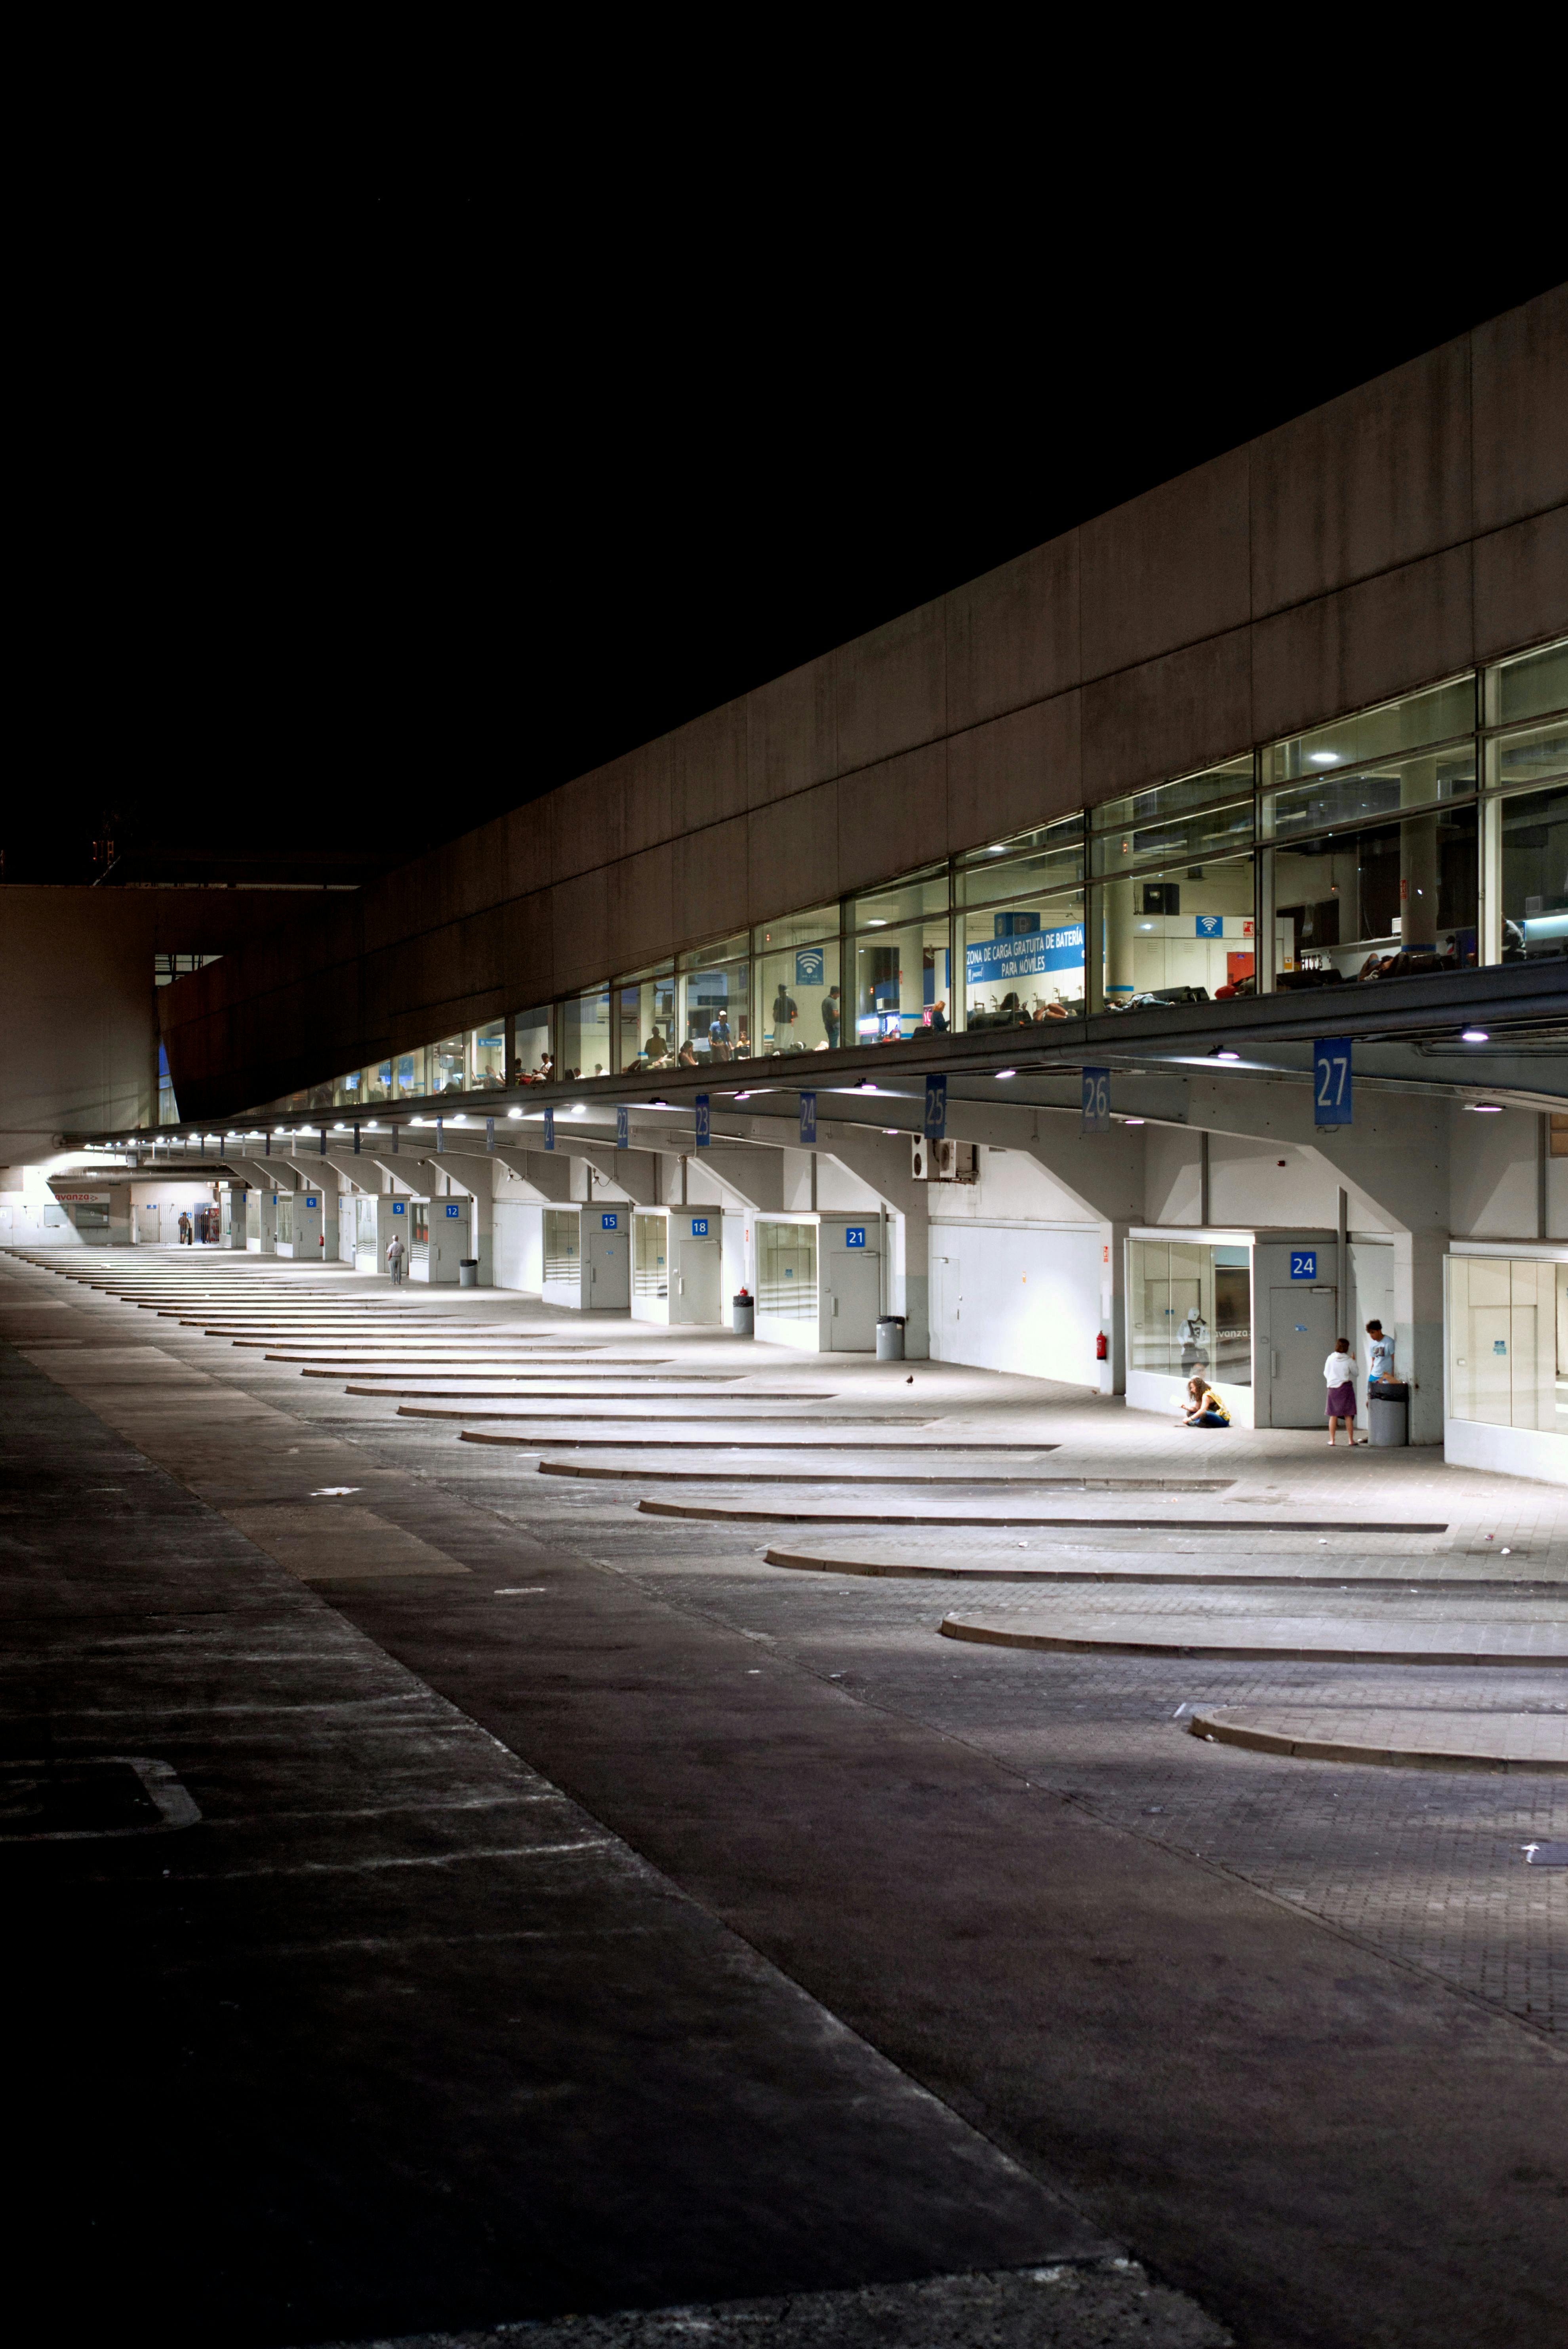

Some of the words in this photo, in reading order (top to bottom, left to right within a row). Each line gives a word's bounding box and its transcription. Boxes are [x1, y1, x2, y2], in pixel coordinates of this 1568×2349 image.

[967, 951, 982, 965] ZONA
[984, 948, 991, 962] DE
[992, 944, 1012, 960] CARGA
[1014, 936, 1044, 955] GRATUITA
[1046, 933, 1054, 949] DE
[1056, 926, 1083, 948] BATERÍA
[1002, 962, 1017, 977] PARA
[1019, 955, 1045, 974] MÓVILES
[1317, 1057, 1347, 1107] 27
[927, 1089, 944, 1125] 25
[1084, 1075, 1107, 1118] 26
[618, 1112, 627, 1138] 22
[697, 1107, 708, 1135] 23
[801, 1099, 815, 1131] 24
[604, 1217, 615, 1226] 15
[694, 1222, 706, 1232] 18
[849, 1232, 862, 1243] 21
[1294, 1258, 1314, 1274] 24
